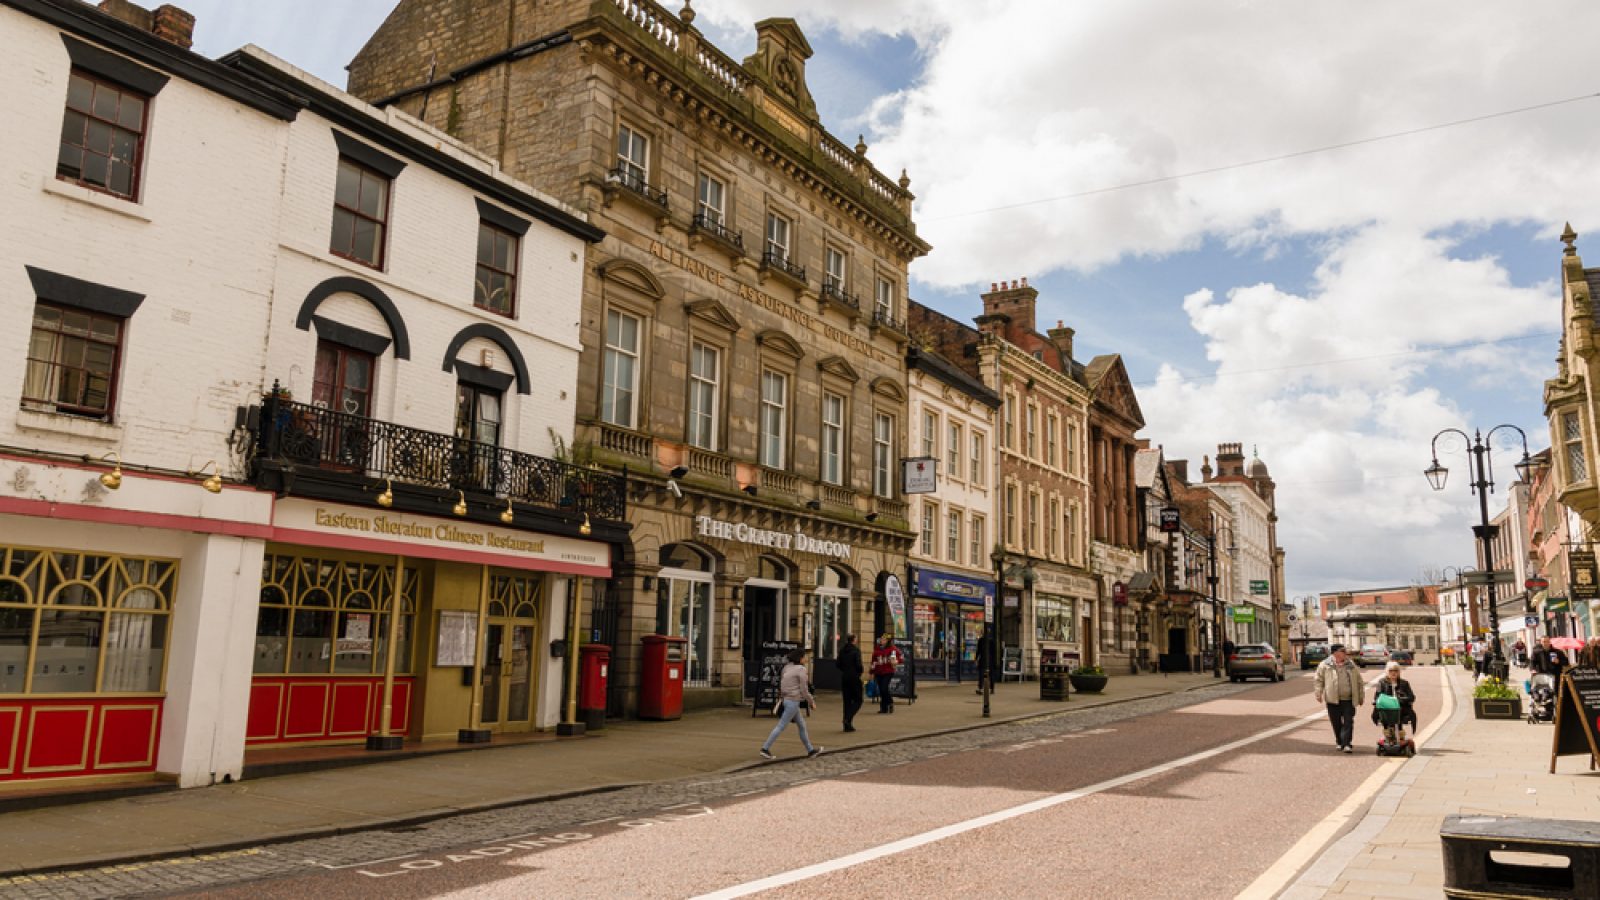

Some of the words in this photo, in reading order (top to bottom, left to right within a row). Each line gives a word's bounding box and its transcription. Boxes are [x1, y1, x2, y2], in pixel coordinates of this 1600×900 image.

[650, 240, 728, 287] ALLIANCE
[738, 284, 815, 330] ASSURANCE
[315, 508, 370, 532] Eastern
[373, 516, 433, 539] Sheraton
[435, 524, 484, 546] Chinese
[487, 531, 545, 554] Restaurant
[696, 515, 733, 540] THE
[736, 522, 792, 550] CRAFTY
[794, 531, 851, 559] DRAGON
[356, 831, 593, 878] LOADING
